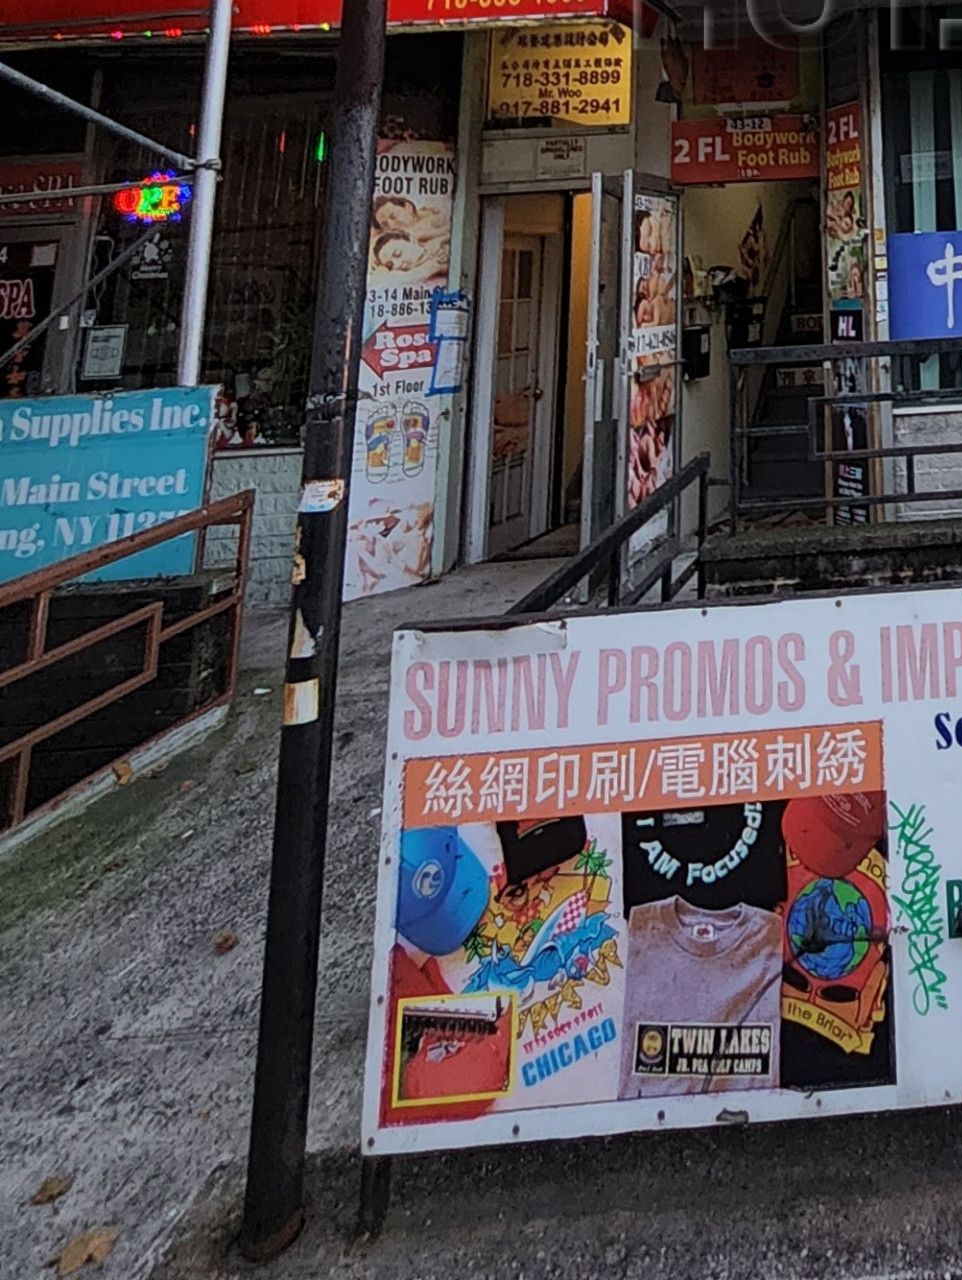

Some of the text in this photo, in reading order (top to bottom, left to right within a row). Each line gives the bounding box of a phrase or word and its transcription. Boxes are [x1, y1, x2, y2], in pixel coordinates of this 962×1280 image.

[501, 68, 622, 89] 718-331-8899
[537, 87, 583, 99] Mr. Woo
[499, 98, 621, 115] 917-881-2941
[827, 114, 860, 145] 2 FL
[673, 135, 731, 164] 2 FL
[737, 148, 812, 167] Foot Rub
[418, 176, 450, 195] RUB
[379, 349, 432, 370] Spa
[372, 380, 424, 399] 1st Floor
[9, 397, 207, 448] Supplies Inc.
[1, 468, 189, 507] Main Street
[51, 515, 100, 548] NY
[402, 650, 581, 741] SUNNY
[599, 632, 806, 725] PROMOS
[827, 628, 864, 708] &
[521, 1016, 618, 1089] CHICAGO
[671, 1024, 771, 1056] TWIN LAKES
[733, 1057, 763, 1073] CAMPS
